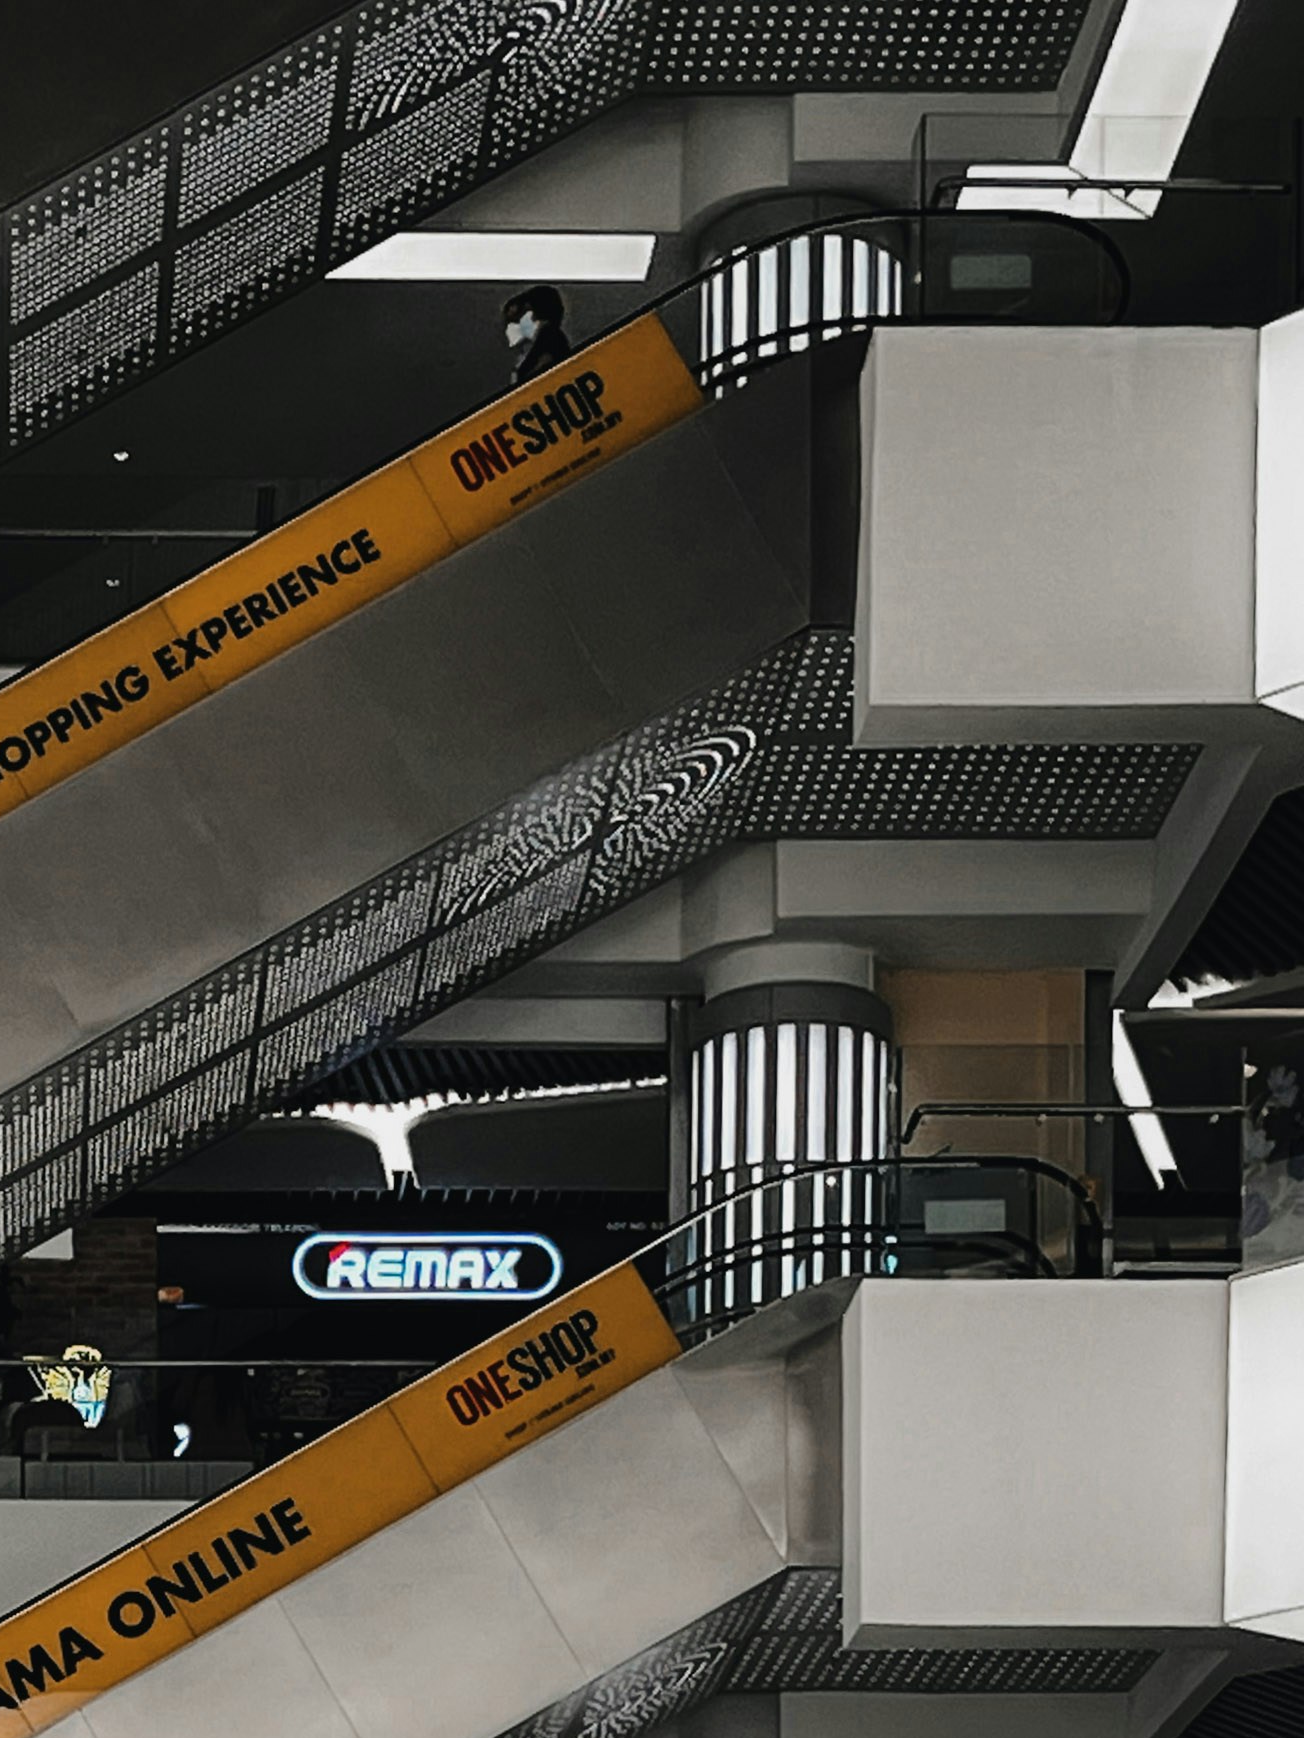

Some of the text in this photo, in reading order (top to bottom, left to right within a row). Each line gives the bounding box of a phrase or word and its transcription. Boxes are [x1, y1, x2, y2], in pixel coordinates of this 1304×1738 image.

[451, 371, 604, 491] ONESHOP
[152, 528, 382, 681] EXPERIENCE
[326, 1241, 523, 1289] REMAX
[446, 1309, 599, 1426] ONESHOP
[107, 1498, 312, 1639] ONLINE
